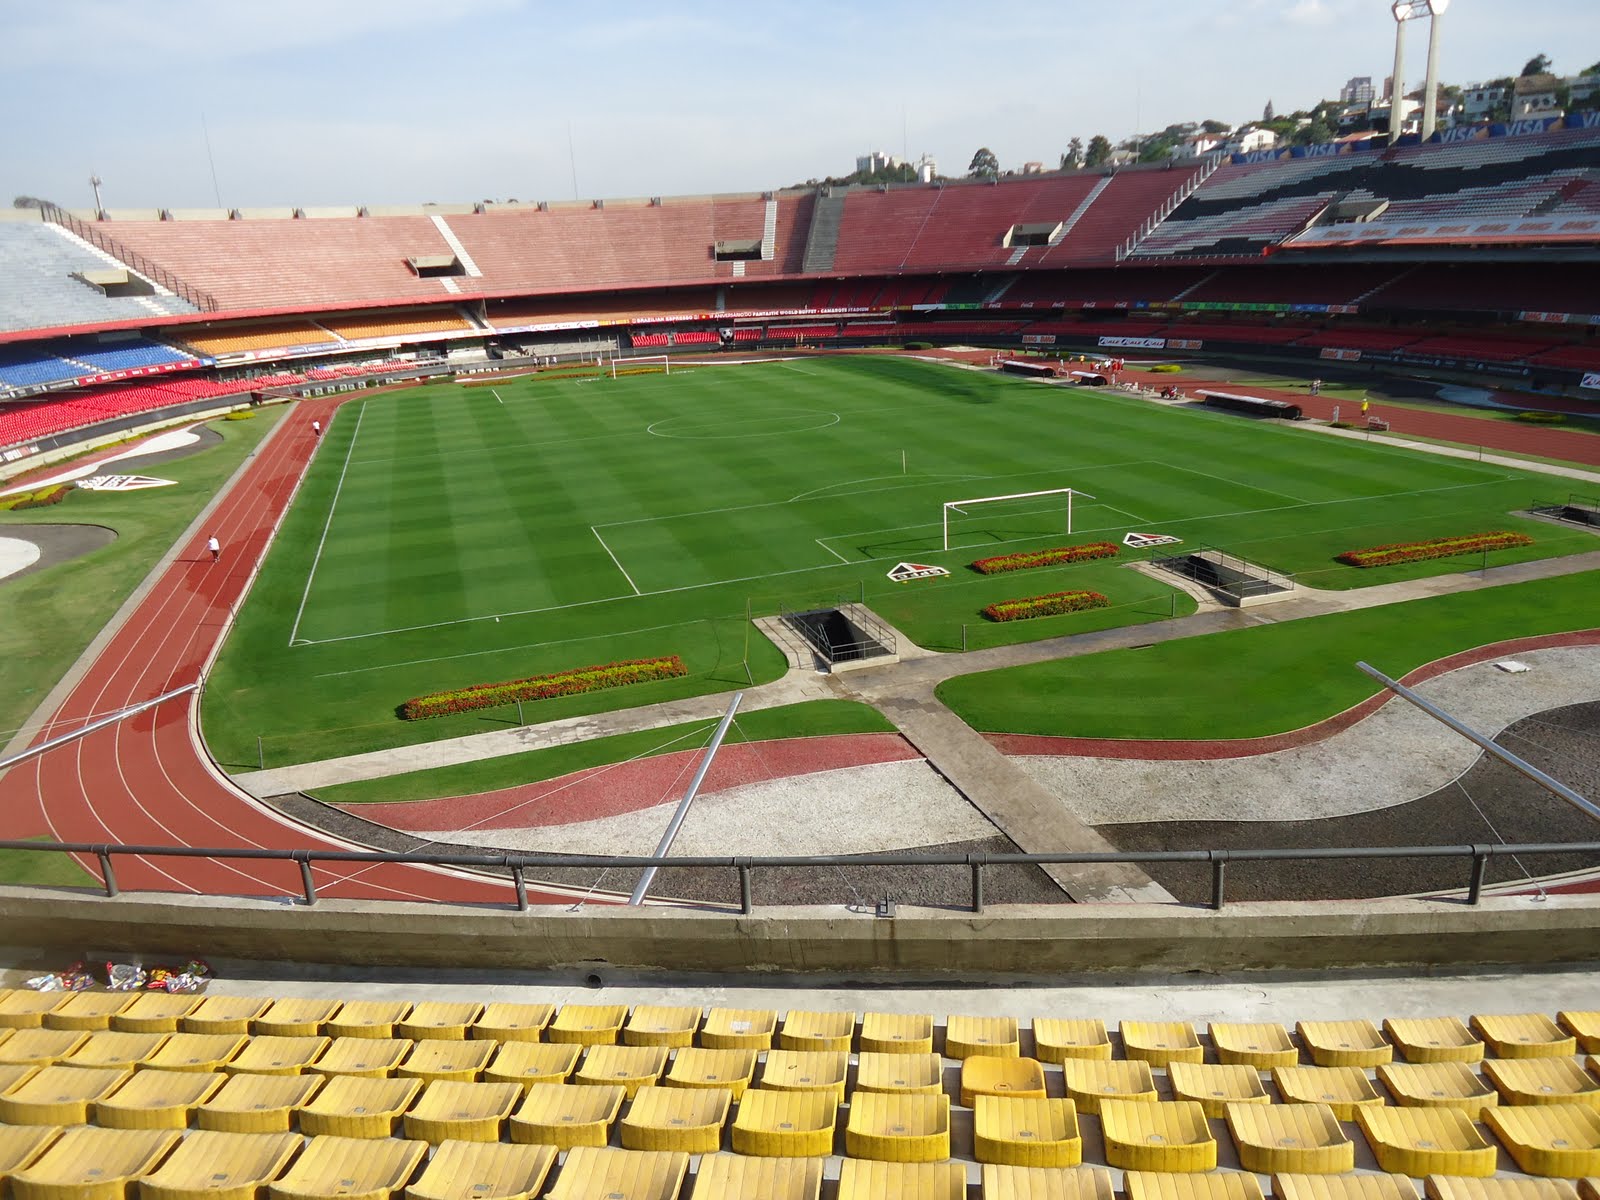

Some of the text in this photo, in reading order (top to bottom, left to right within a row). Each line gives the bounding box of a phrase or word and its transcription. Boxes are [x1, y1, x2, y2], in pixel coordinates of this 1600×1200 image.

[1439, 126, 1477, 144] VISA
[1504, 119, 1544, 137] VISA
[1245, 151, 1276, 164] VISA
[1303, 143, 1337, 158] VISA
[1023, 336, 1055, 344] BMG BMG
